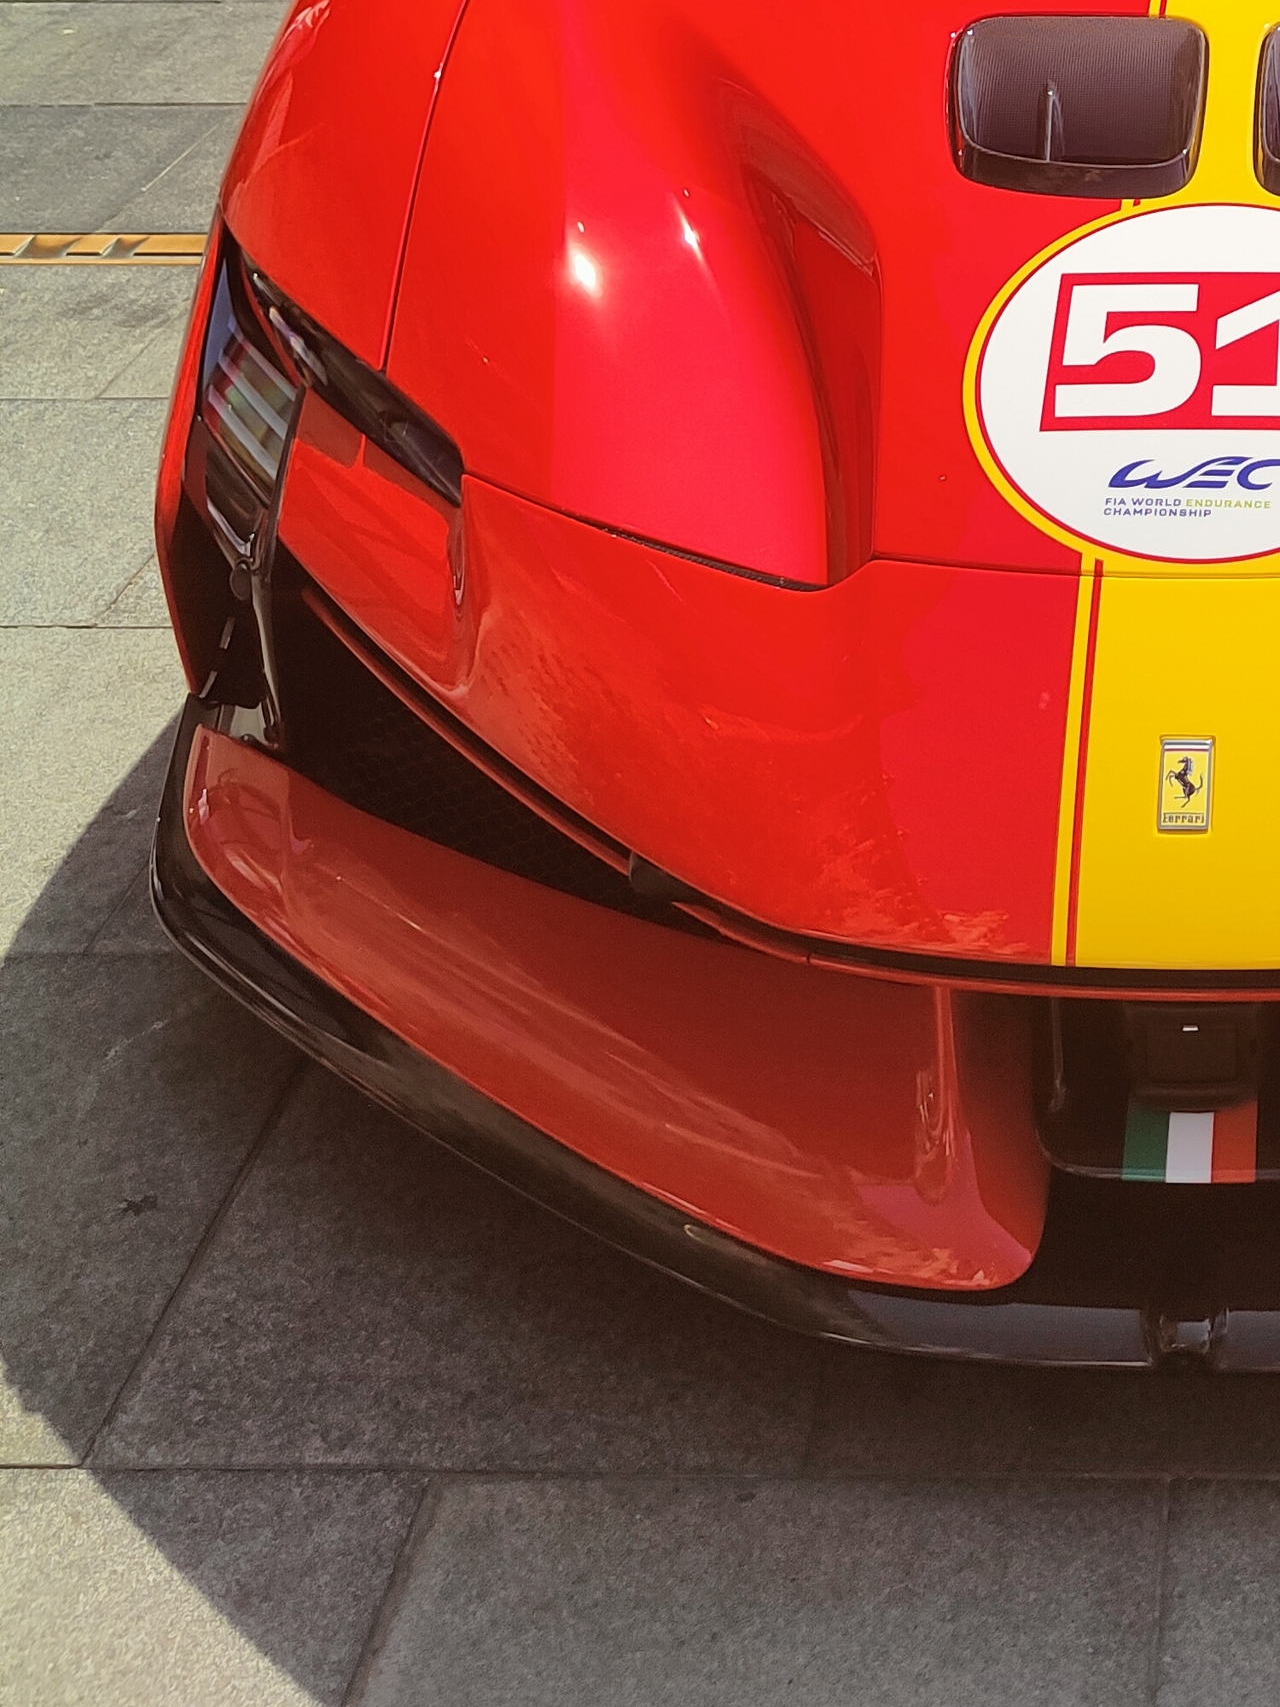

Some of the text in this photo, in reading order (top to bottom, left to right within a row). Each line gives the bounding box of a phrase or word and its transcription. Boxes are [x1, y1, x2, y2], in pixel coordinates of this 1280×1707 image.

[1104, 497, 1271, 509] FIA WORLD ENDURANCE
[1103, 507, 1212, 517] CHAMPIONSHIP
[1162, 812, 1205, 824] Ferrari
